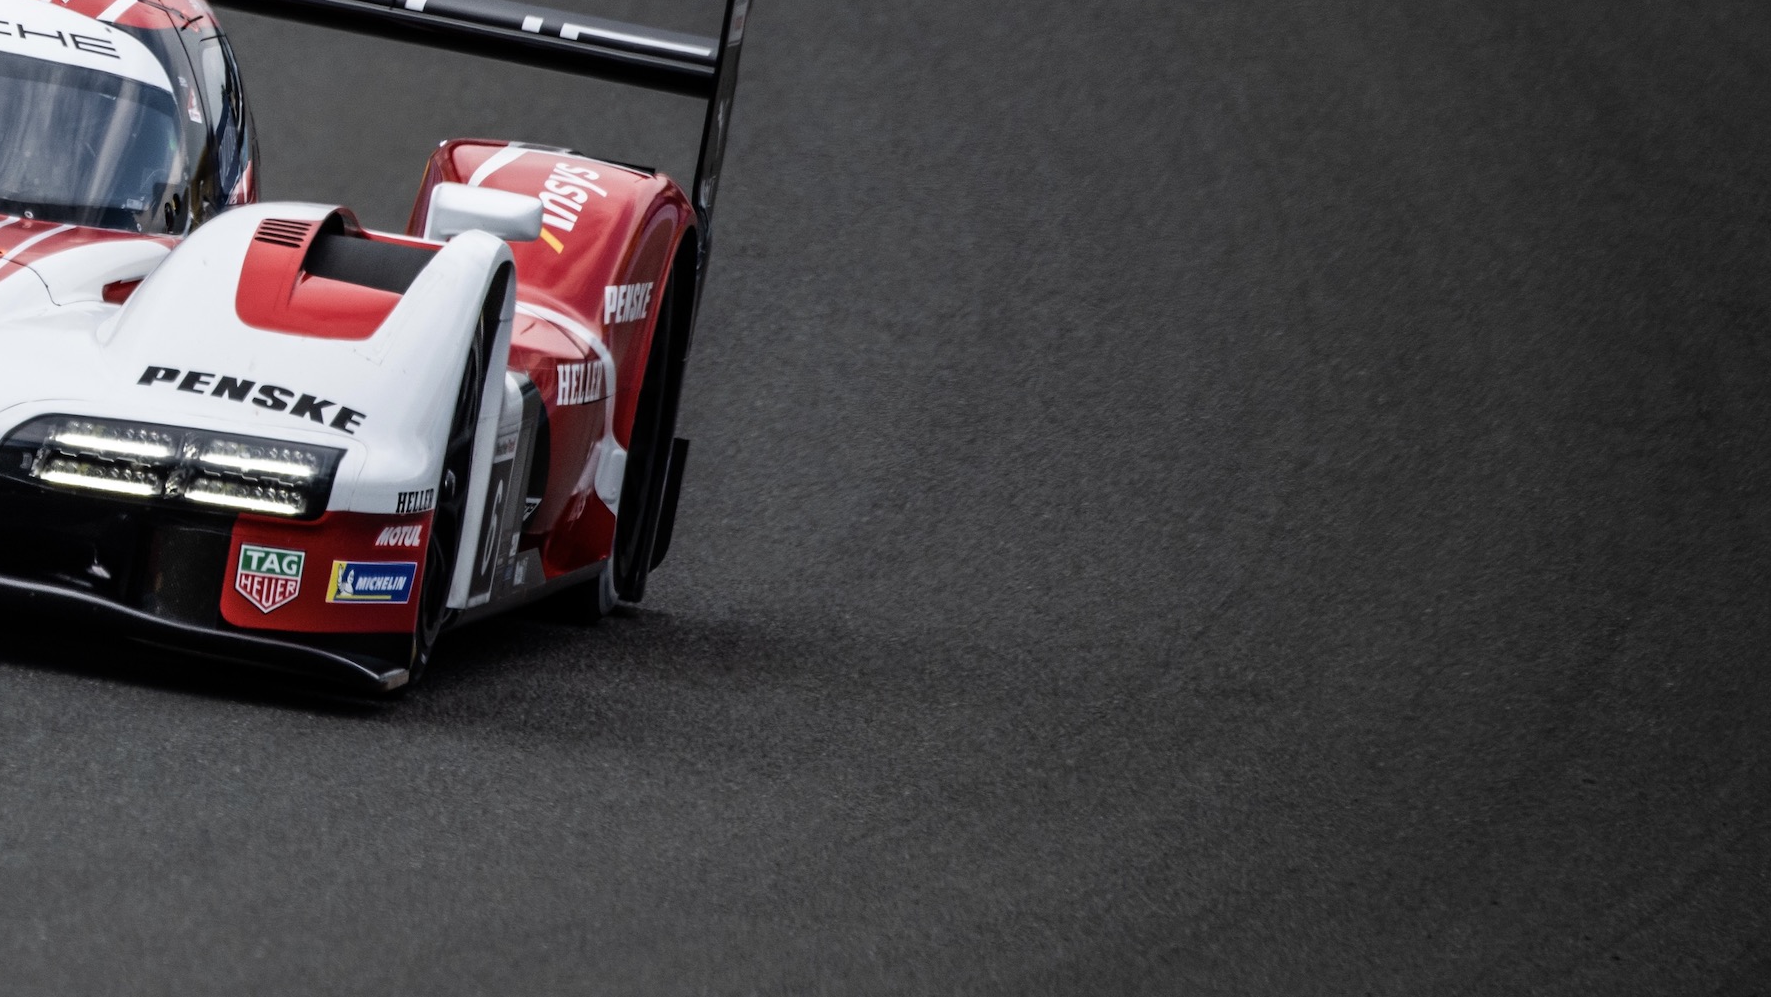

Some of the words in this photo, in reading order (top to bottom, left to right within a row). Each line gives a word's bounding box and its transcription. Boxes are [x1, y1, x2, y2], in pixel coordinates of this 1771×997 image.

[603, 281, 655, 325] PENSKE
[137, 365, 367, 434] PENSKE
[375, 525, 423, 547] MOTUL
[480, 479, 504, 577] 6
[246, 550, 298, 575] TAG
[240, 573, 297, 608] HEUER
[355, 574, 407, 592] MICHELIN
